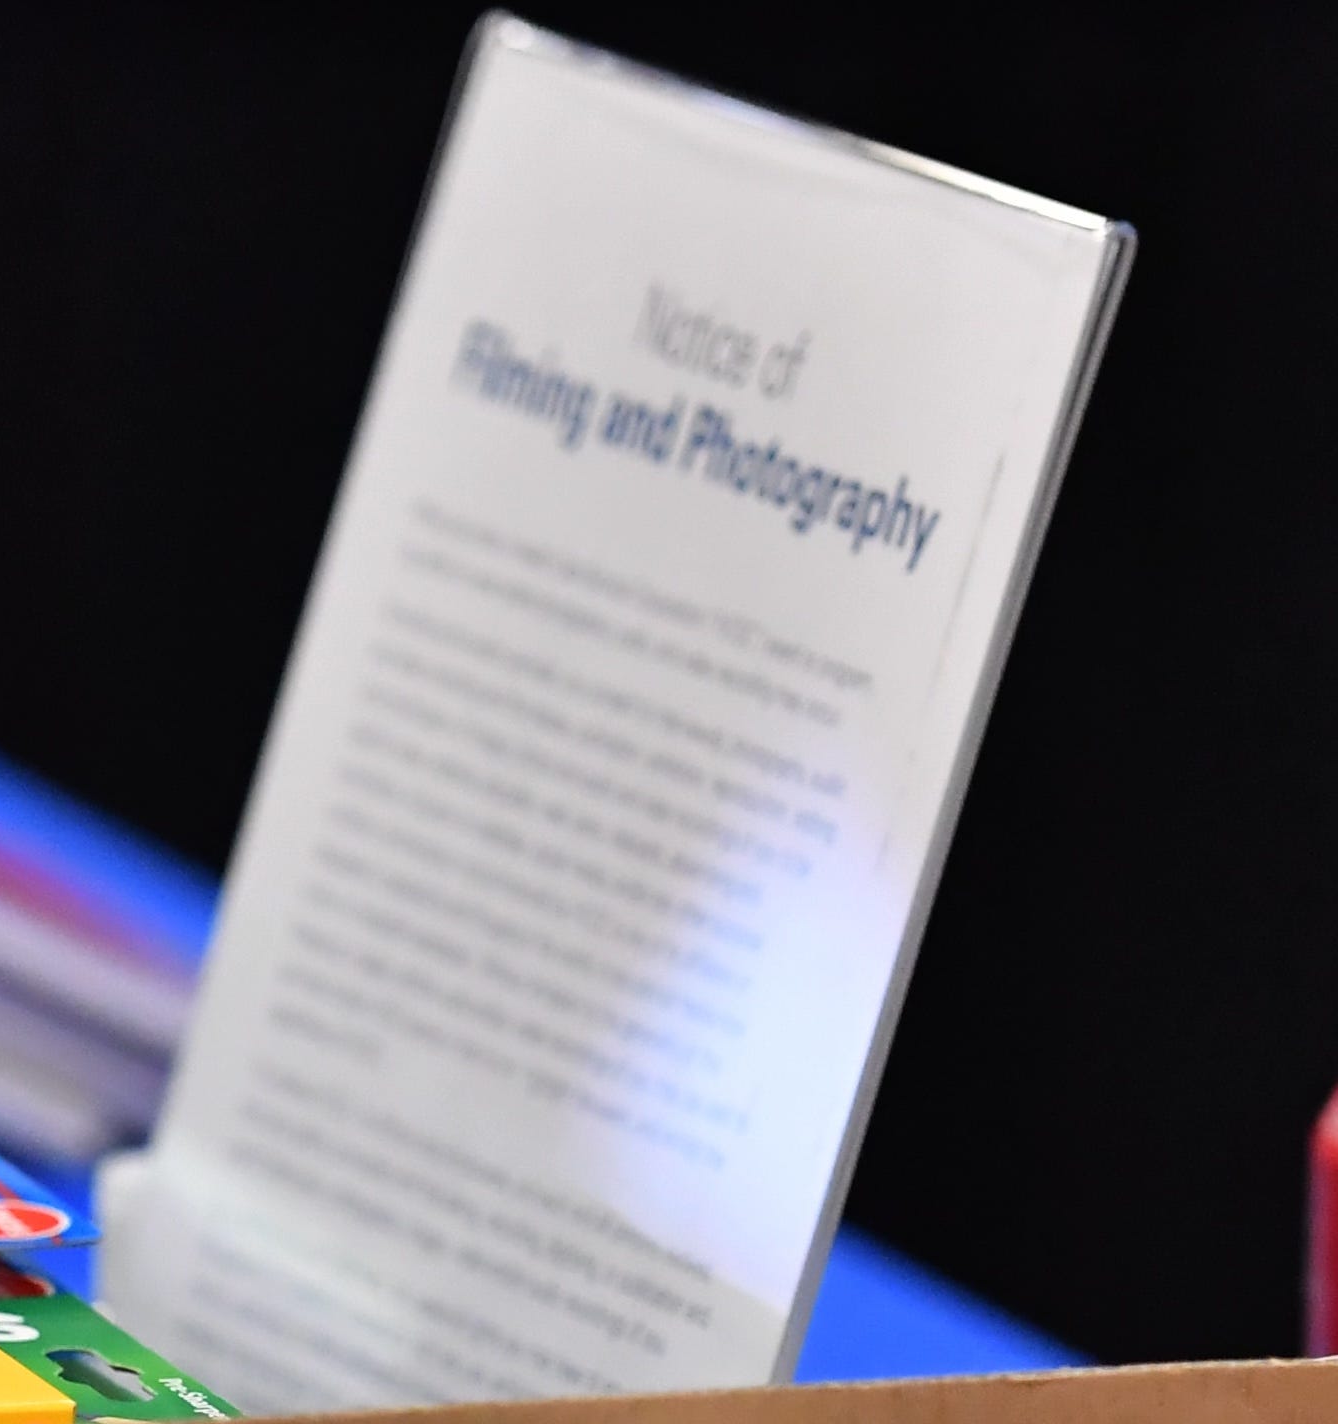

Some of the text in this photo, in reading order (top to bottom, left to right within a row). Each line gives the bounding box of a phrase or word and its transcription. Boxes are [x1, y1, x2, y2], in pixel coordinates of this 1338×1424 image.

[601, 392, 690, 464] and
[679, 404, 941, 574] Photography
[157, 1376, 231, 1421] Pre-Sharpe
